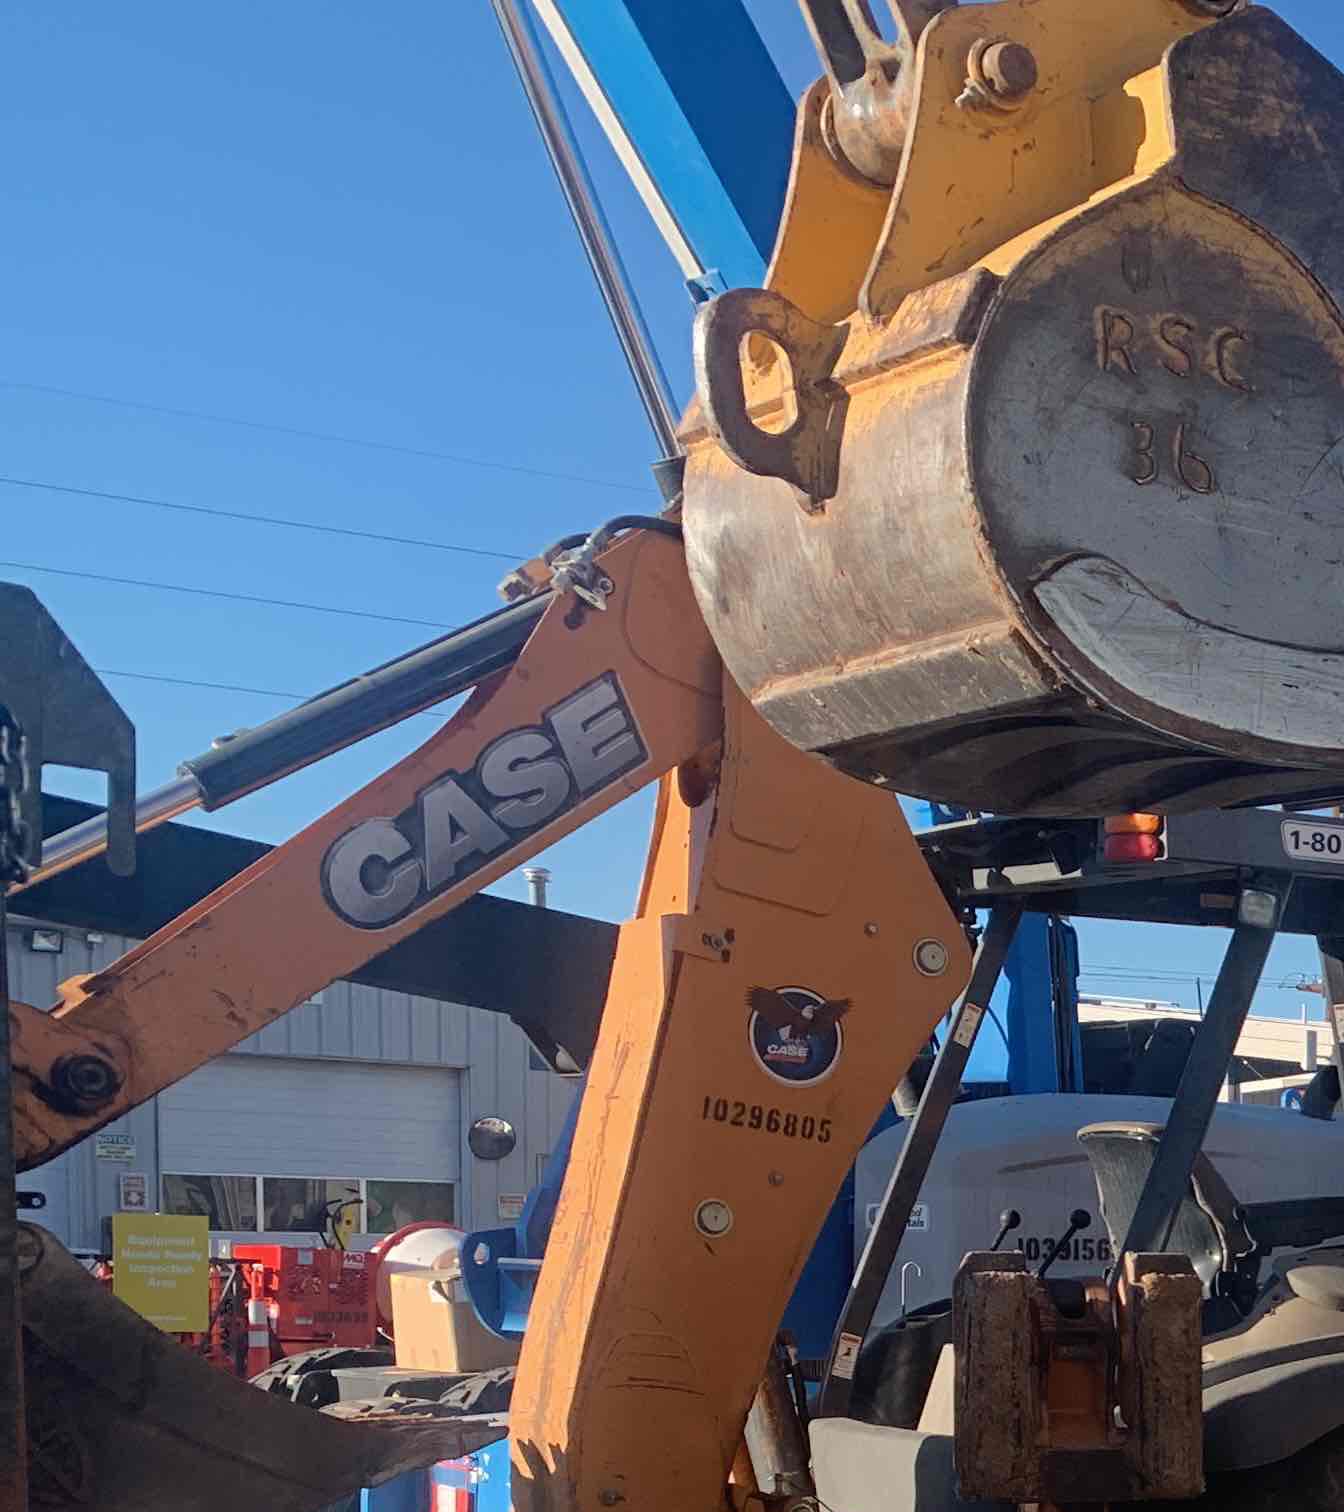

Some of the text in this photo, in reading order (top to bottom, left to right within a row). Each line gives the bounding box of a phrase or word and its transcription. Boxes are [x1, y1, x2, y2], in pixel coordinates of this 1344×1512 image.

[1093, 304, 1256, 393] RSC
[1130, 421, 1217, 495] 36
[321, 669, 650, 930] CASE
[767, 1044, 808, 1057] CASE
[702, 1096, 832, 1143] 10296805
